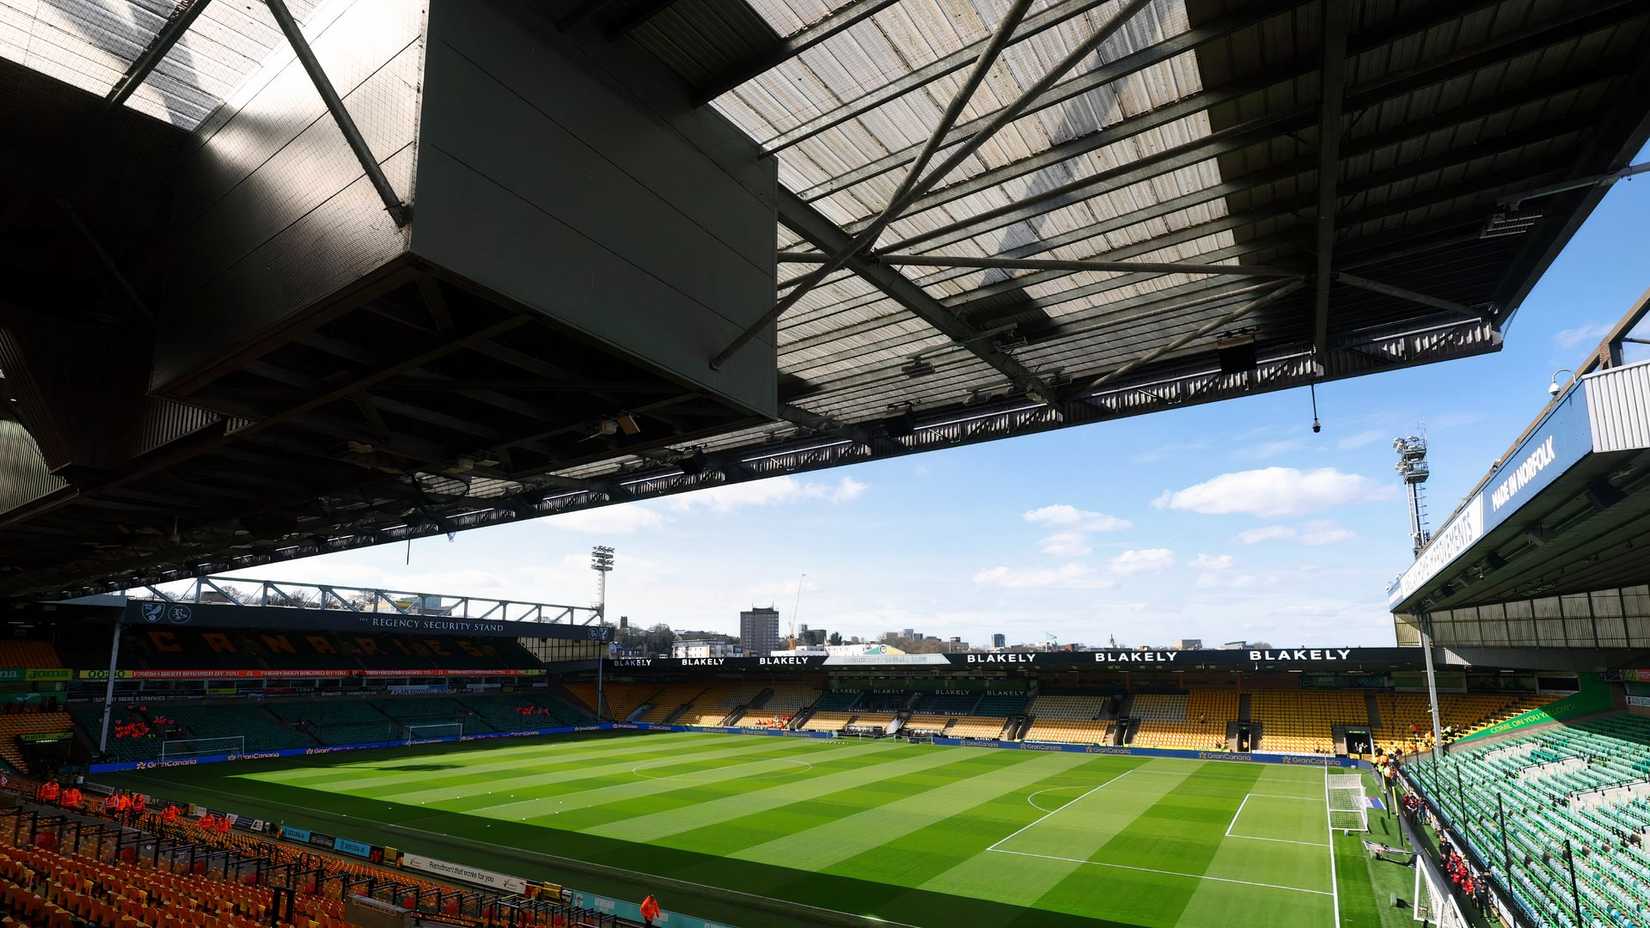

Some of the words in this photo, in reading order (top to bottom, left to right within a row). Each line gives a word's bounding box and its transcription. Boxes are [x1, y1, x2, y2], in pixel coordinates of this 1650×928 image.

[1492, 479, 1510, 512] MADE
[1508, 472, 1518, 497] IN
[1516, 435, 1556, 490] NORFOLK
[373, 618, 419, 629] REGENCY
[423, 621, 470, 631] SECURITY
[474, 624, 504, 633] STAND
[967, 653, 1036, 664] BLAKELY
[1095, 651, 1178, 663] BLAKELY
[1250, 648, 1350, 661] BLAKELY
[682, 658, 725, 667] BLAKELY
[759, 657, 808, 665] BLAKELY
[986, 689, 1025, 697] BLAKELY
[1511, 719, 1523, 728] ON
[1524, 714, 1540, 725] YOU
[1207, 752, 1252, 761] GranCanaria
[484, 876, 495, 884] you
